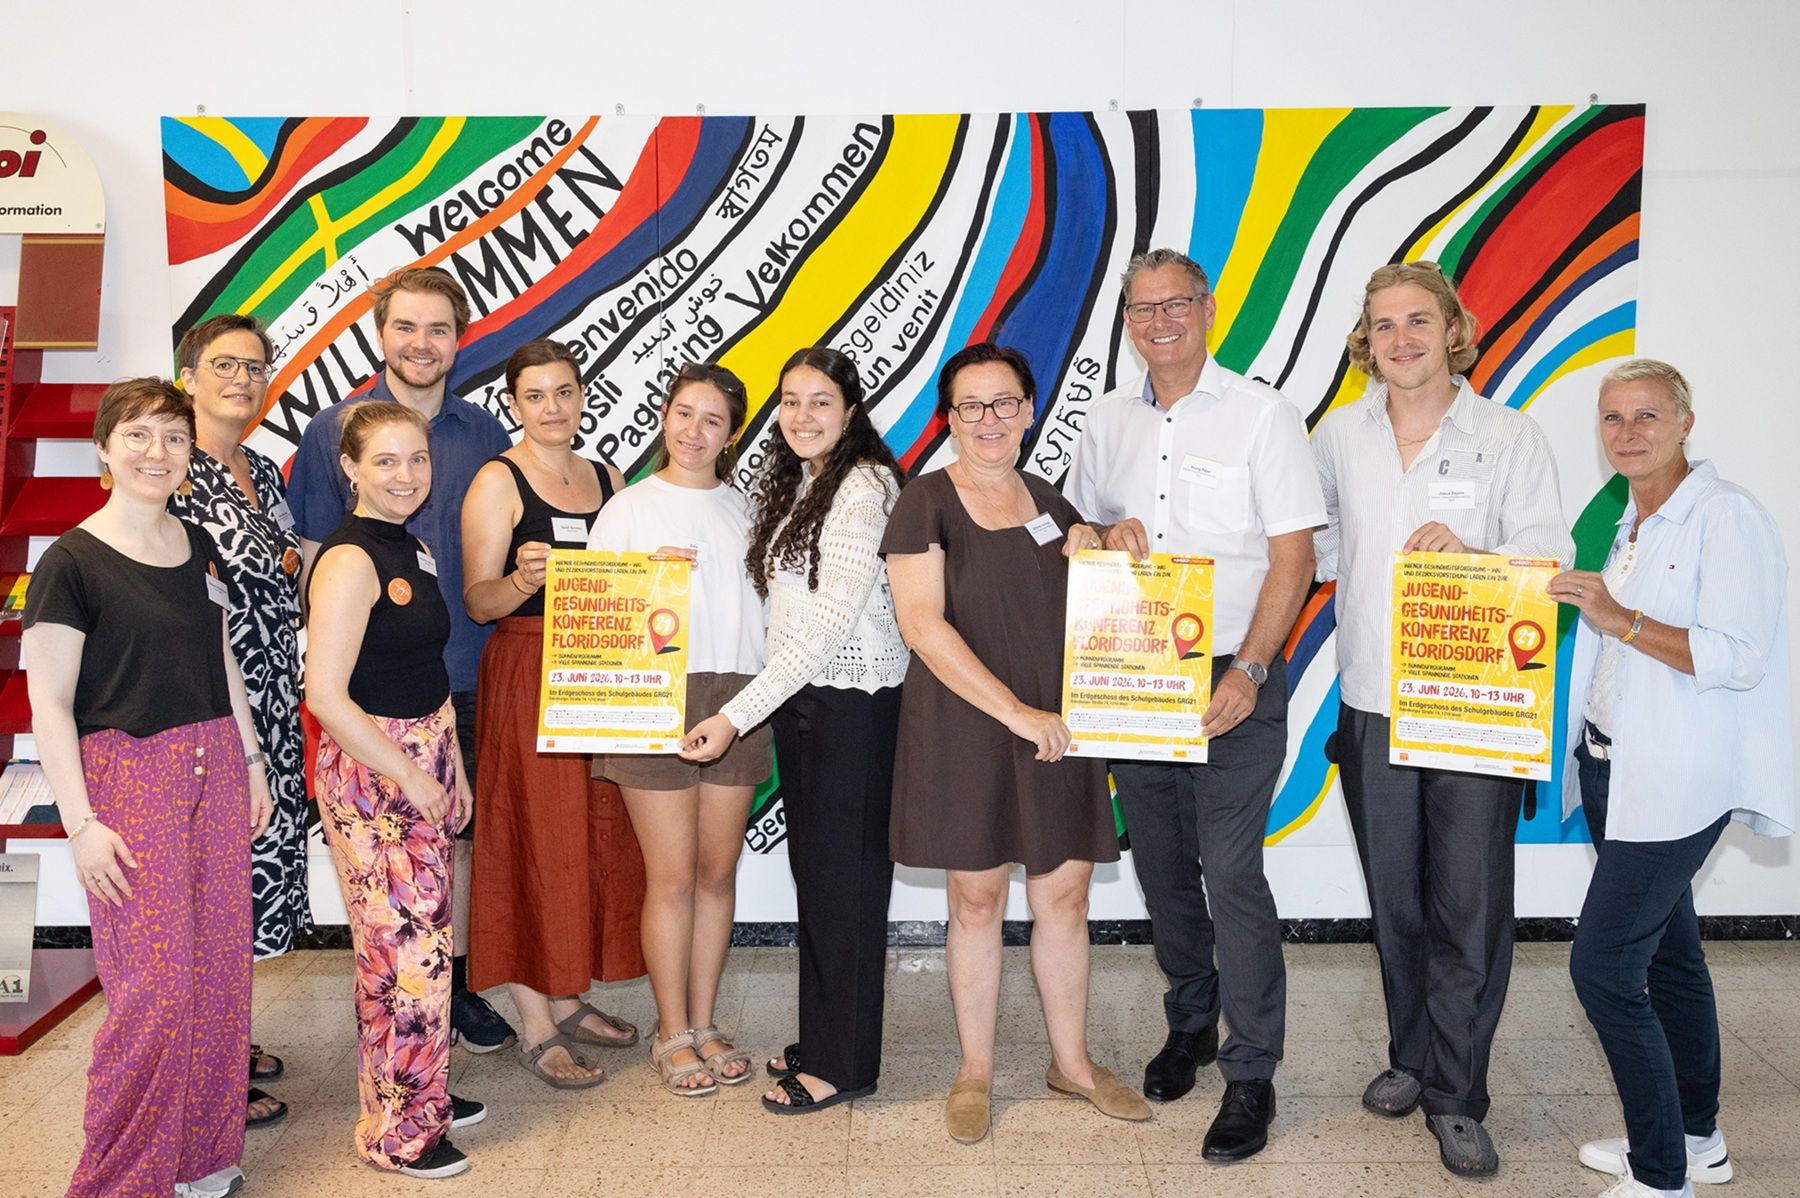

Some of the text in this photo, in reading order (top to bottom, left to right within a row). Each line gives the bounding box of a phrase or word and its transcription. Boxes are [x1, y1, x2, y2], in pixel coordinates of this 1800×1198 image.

[724, 122, 882, 309] Velkommen
[261, 145, 625, 450] WILLMMEN
[567, 248, 699, 366] envenido
[840, 250, 936, 366] şgeldiniz
[861, 289, 939, 398] un venit
[570, 373, 623, 450] ošli
[1438, 459, 1450, 476] C
[554, 577, 613, 593] JUGEND-
[1402, 582, 1468, 600] JUGEND-
[553, 596, 651, 612] GESUNDHEITS-
[1401, 602, 1512, 623] GESUNDHEITS-
[552, 614, 632, 631] KONFERENZ
[655, 615, 671, 631] 21
[1073, 618, 1156, 635] KONFERENZ
[1179, 620, 1196, 637] 21
[1401, 621, 1490, 643] KONFERENZ
[1517, 628, 1536, 647] 21
[551, 672, 565, 682] 23.
[643, 675, 662, 685] UHR
[1073, 675, 1086, 685] 23.
[1166, 680, 1186, 690] UHR
[608, 690, 652, 698] Schulgebäudes
[1080, 693, 1118, 701] Erdgeschoss
[1131, 695, 1176, 704] Schulgebäudes
[1401, 683, 1415, 693] 23.
[1503, 692, 1525, 704] UHR
[1409, 701, 1449, 711] Erdgeschoss
[1464, 706, 1514, 717] Schulgebäudes
[1515, 711, 1538, 719] GRG21
[0, 862, 14, 873] ix.
